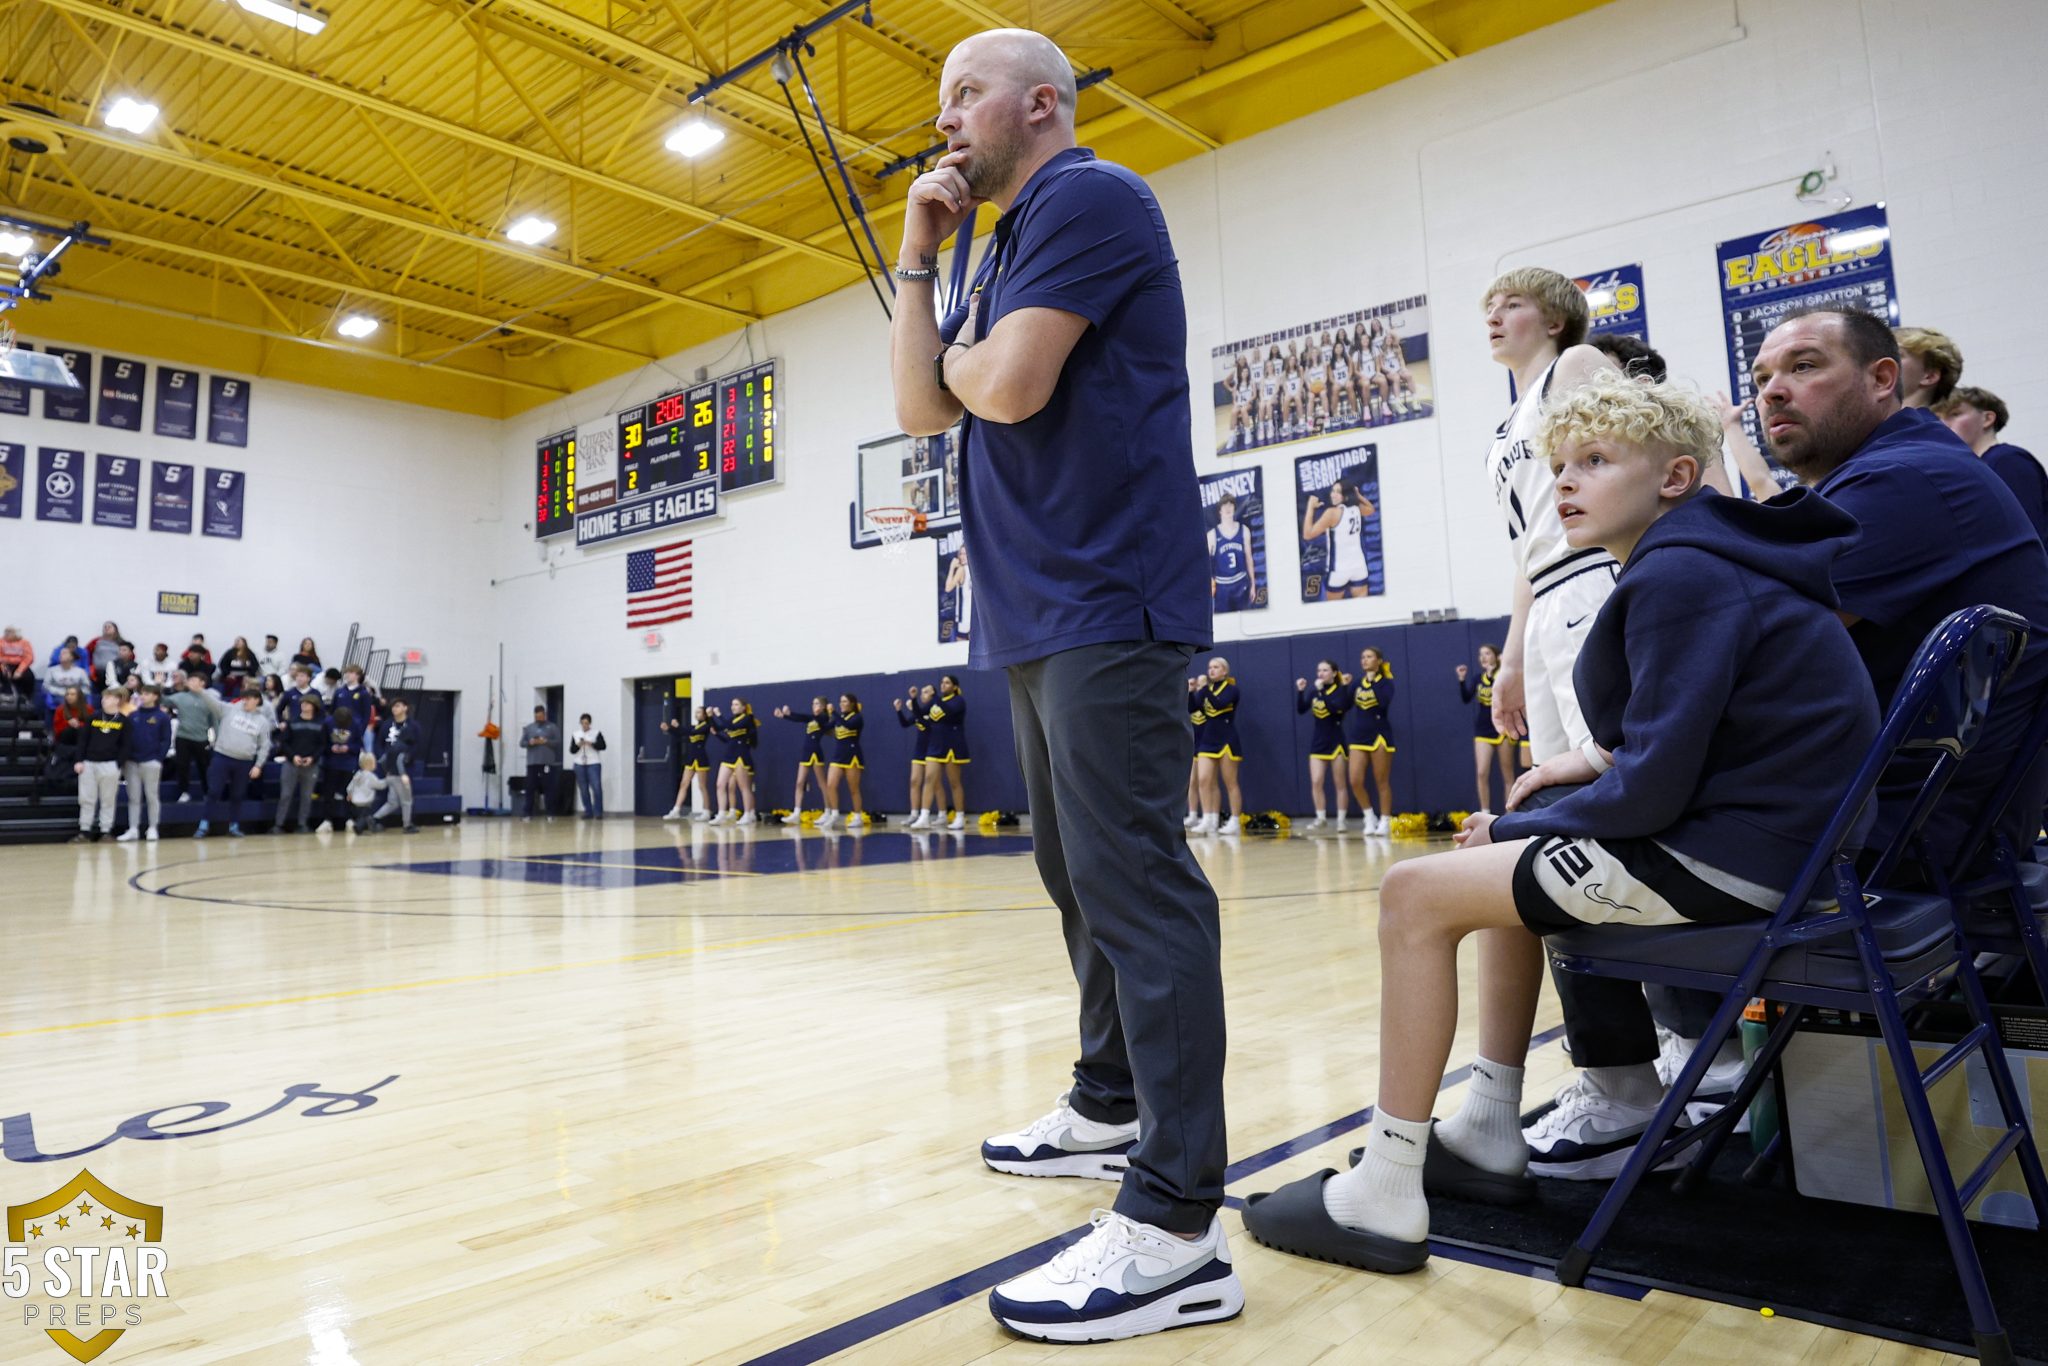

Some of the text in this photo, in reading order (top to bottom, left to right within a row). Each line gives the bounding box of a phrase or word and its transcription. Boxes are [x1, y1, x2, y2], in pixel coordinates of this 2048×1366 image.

[1740, 261, 1870, 294] BASKETBALL
[1749, 299, 1803, 320] JACKSON
[1807, 286, 1863, 307] GRATTON
[728, 388, 736, 402] 3
[656, 393, 685, 425] 2:06
[690, 385, 712, 401] HOME
[625, 400, 713, 449] 30 26
[723, 422, 736, 438] 21
[670, 426, 678, 445] 2
[723, 438, 736, 455] 22
[628, 471, 637, 489] 2
[699, 451, 708, 470] 3
[723, 456, 736, 472] 23
[578, 486, 715, 541] HOME OF THE EAGLES
[1228, 552, 1236, 569] 3
[160, 593, 197, 605] HOME
